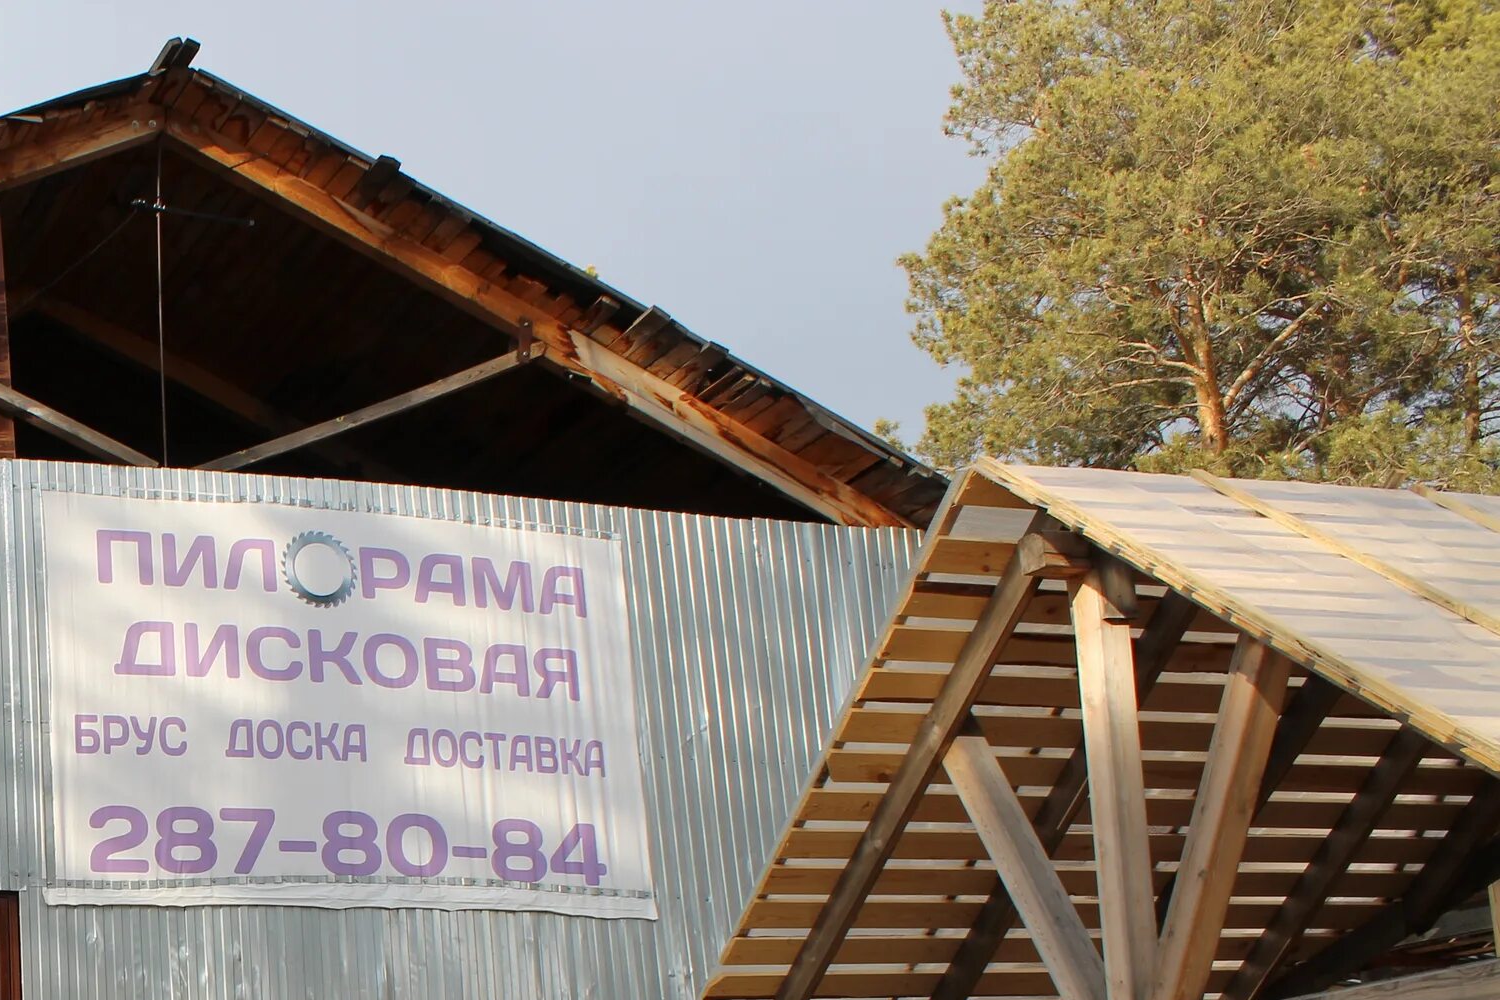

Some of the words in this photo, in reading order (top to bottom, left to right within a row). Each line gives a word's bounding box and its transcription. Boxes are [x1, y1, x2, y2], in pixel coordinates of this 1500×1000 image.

[114, 621, 581, 701] ДИСКОВАЯ
[75, 714, 188, 756] БРУС
[225, 719, 367, 763] ДОСКА
[404, 727, 605, 777] ДОСТАВКА
[89, 805, 607, 886] 287-80-84
